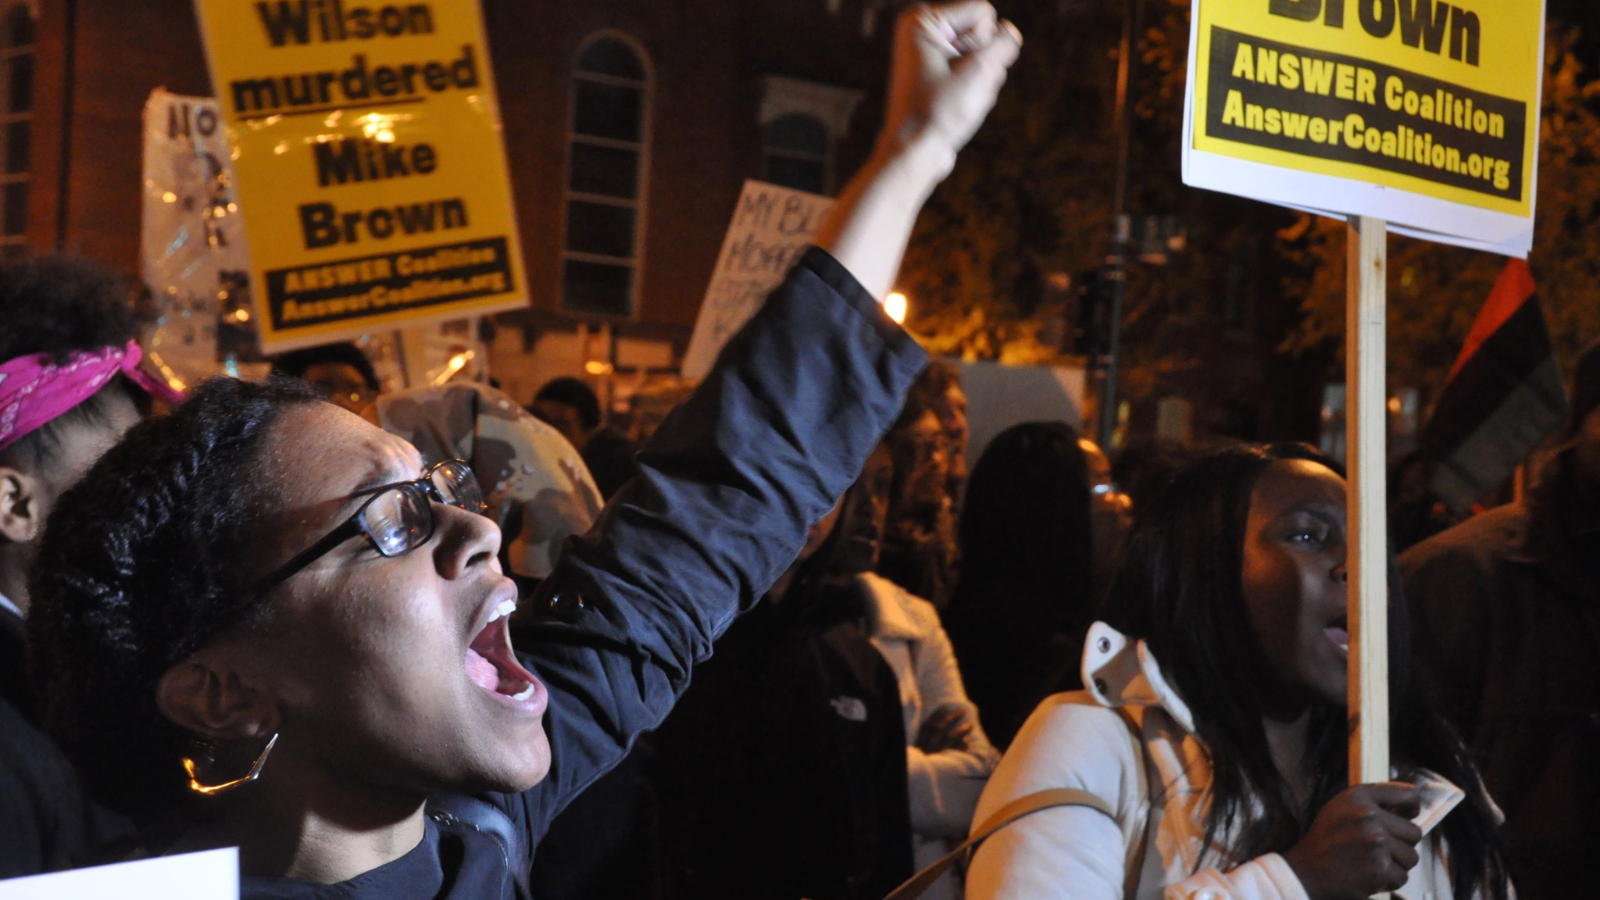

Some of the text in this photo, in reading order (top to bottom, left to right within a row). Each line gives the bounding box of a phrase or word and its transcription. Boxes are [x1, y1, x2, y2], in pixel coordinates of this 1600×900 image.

[257, 0, 434, 46] Wilson
[232, 46, 479, 113] murdered
[1232, 43, 1505, 138] ANSWER Coalition
[313, 138, 438, 188] Mike
[1221, 89, 1511, 191] AnswerCoalition.org
[299, 197, 468, 250] Brown
[283, 246, 497, 294] ANSWER Coalition
[282, 271, 507, 322] AnswerCoalition.org
